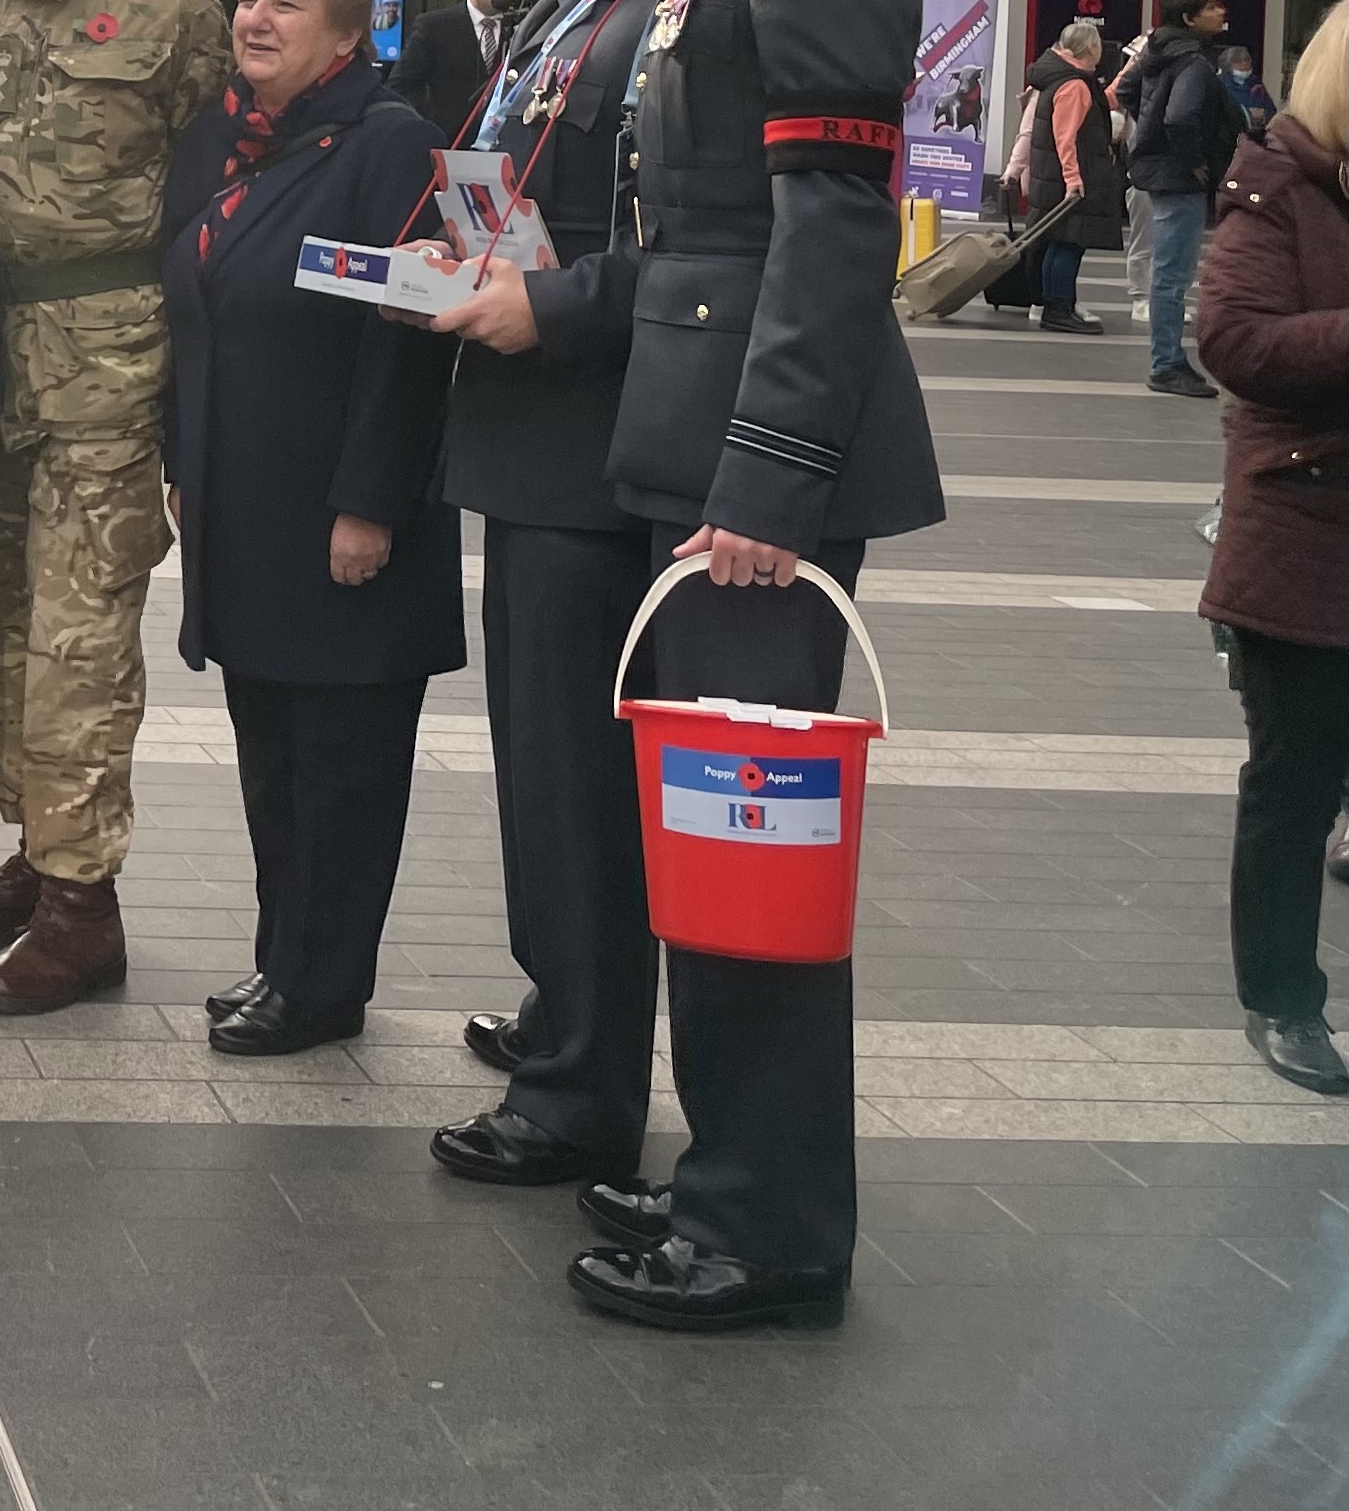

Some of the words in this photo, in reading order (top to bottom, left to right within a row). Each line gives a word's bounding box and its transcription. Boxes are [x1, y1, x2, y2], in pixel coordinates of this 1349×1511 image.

[928, 14, 991, 81] BIRMINGHAM
[704, 764, 737, 782] Poppy
[766, 771, 803, 786] Appeal
